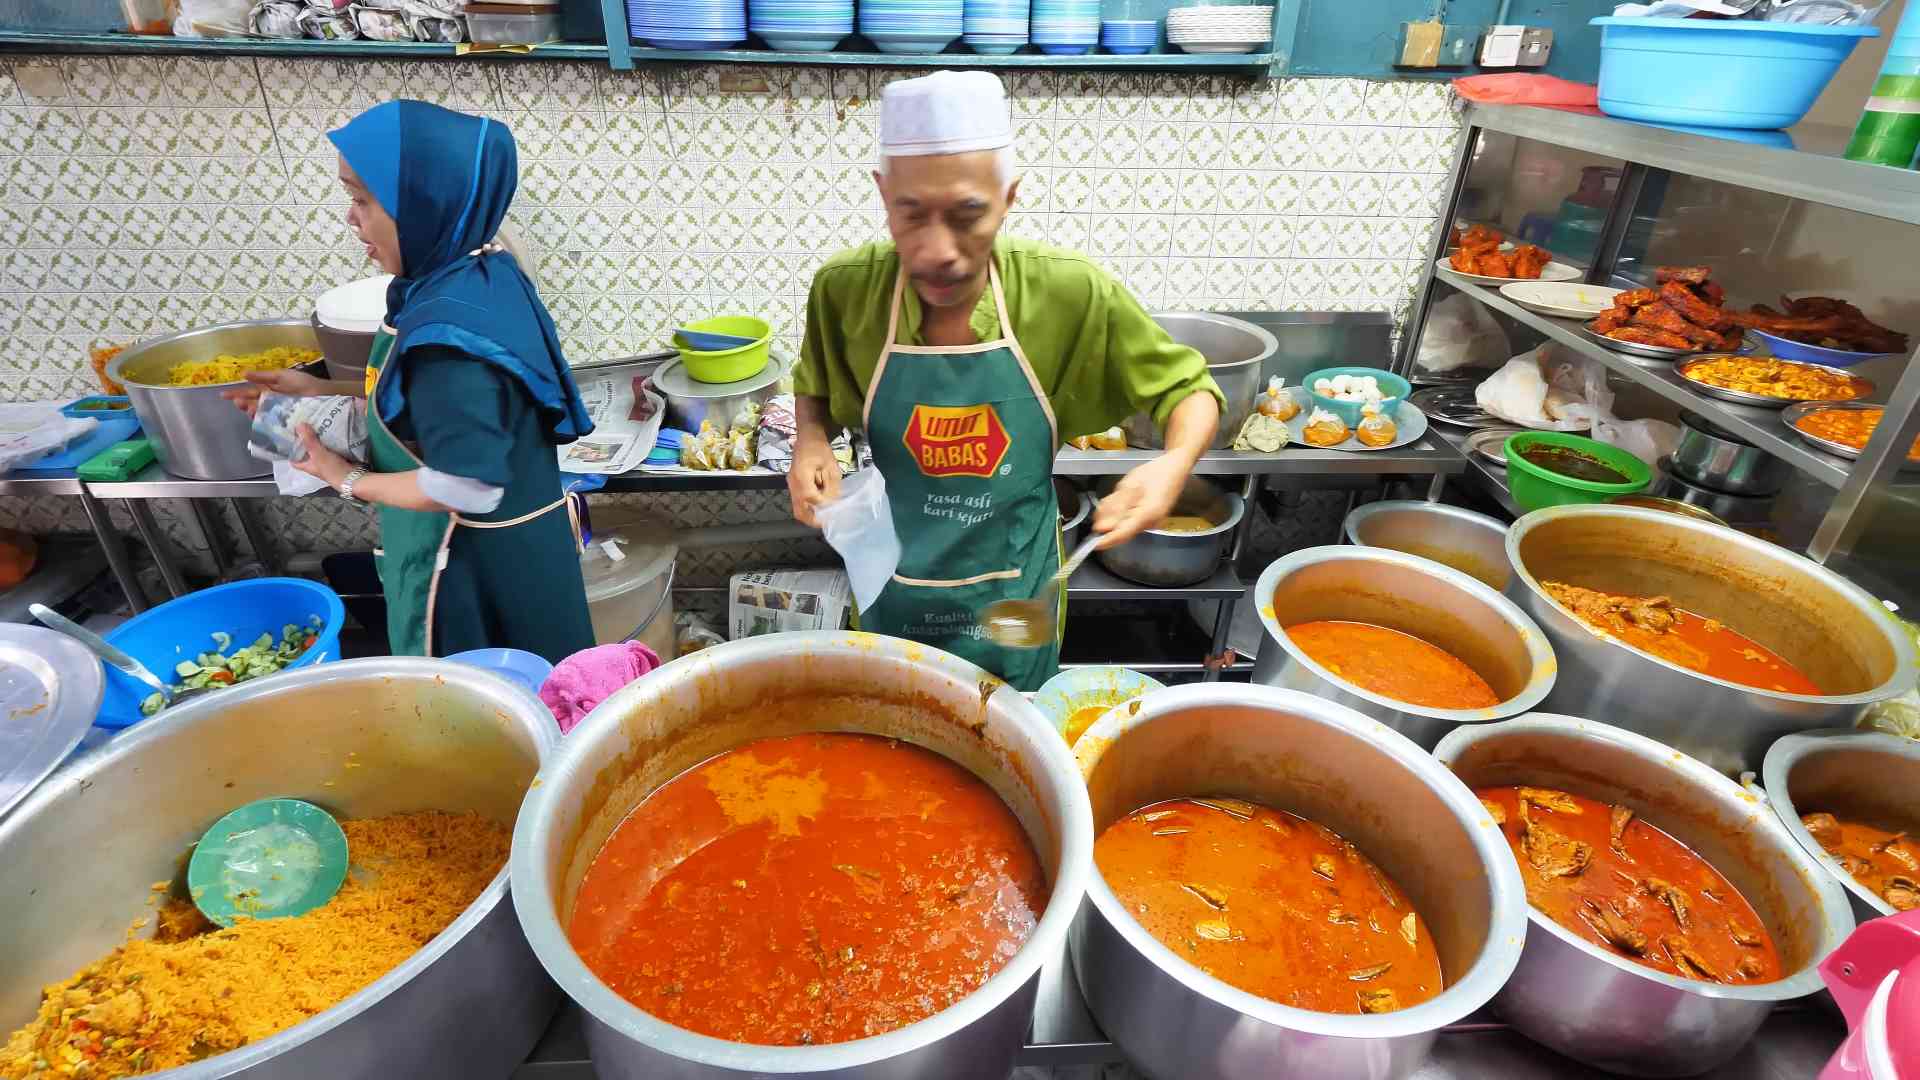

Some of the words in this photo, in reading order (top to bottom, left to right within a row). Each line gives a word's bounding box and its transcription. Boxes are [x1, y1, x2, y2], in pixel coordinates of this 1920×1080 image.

[927, 493, 961, 504] rasa
[964, 492, 992, 509] asli
[923, 503, 955, 519] kari
